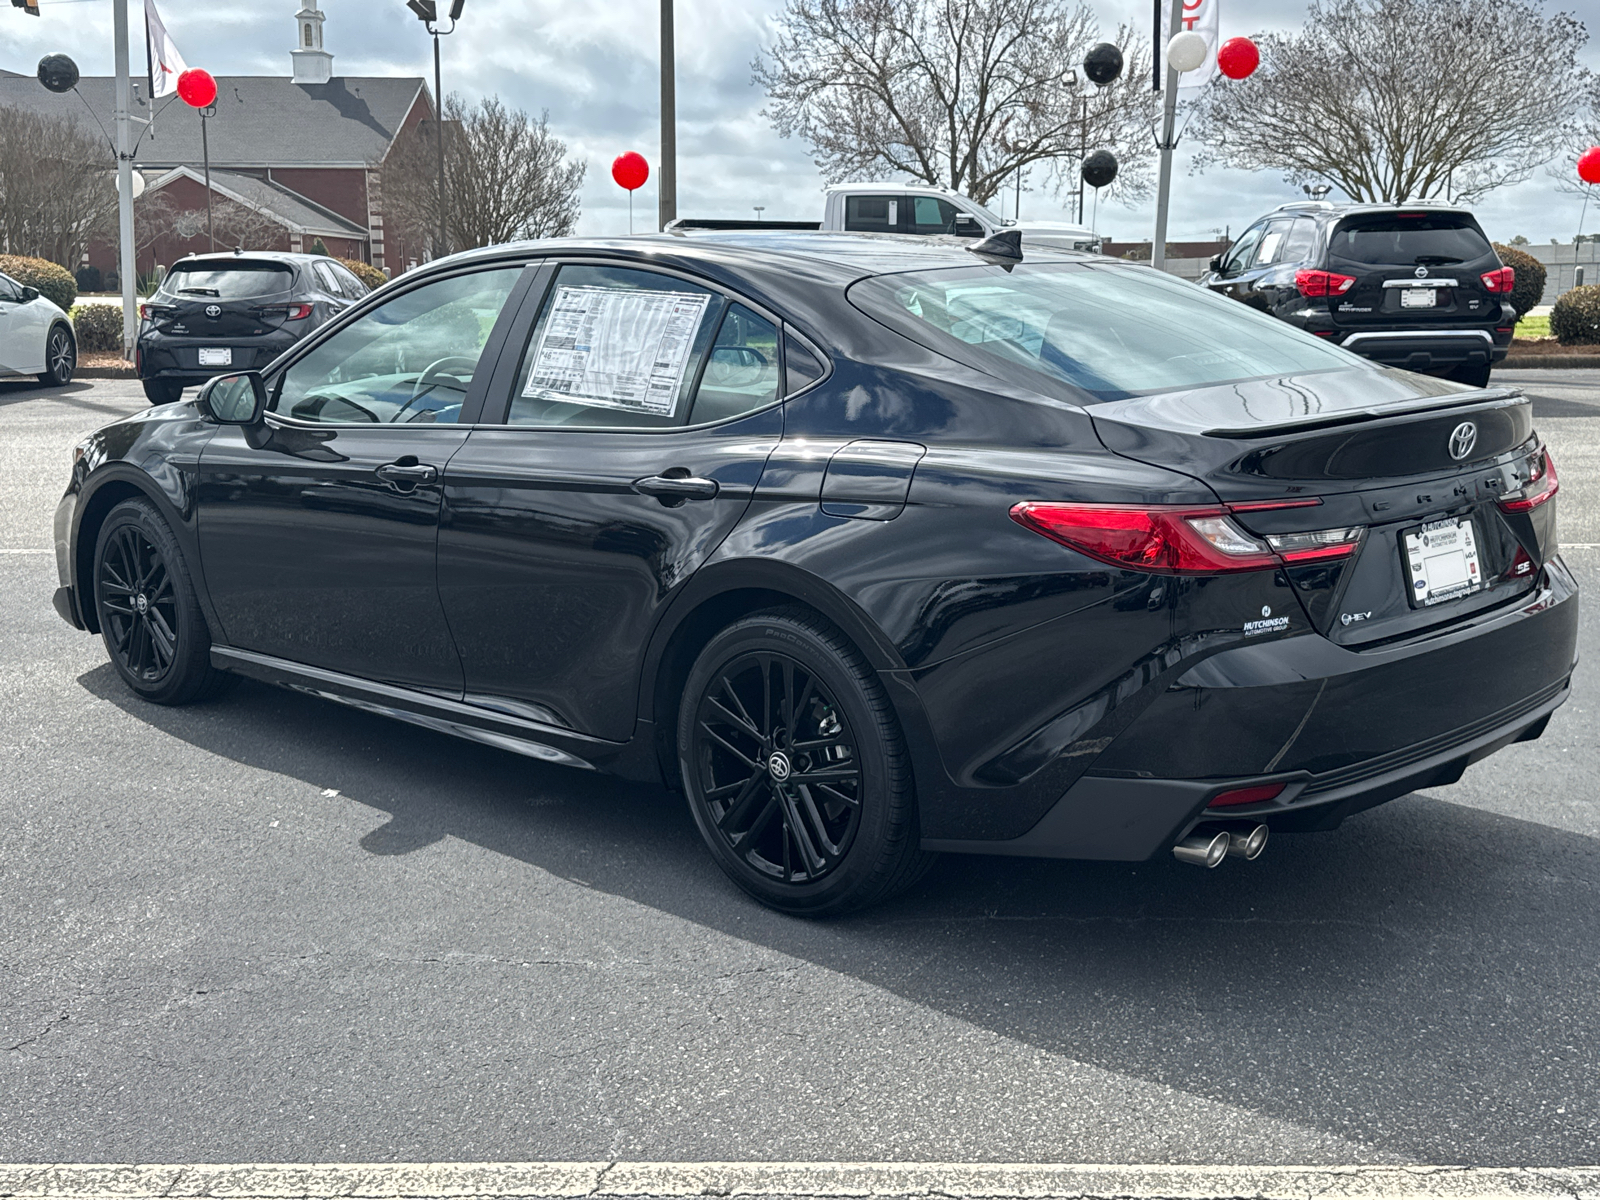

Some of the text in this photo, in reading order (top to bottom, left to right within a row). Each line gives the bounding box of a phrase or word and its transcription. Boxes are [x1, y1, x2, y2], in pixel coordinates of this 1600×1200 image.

[1428, 517, 1459, 531] HUTCHINSON
[1430, 531, 1457, 543] HUTCHINSON
[1517, 560, 1530, 575] SE
[1244, 617, 1289, 630] HUTCHINSON
[1244, 624, 1288, 636] AUTOMOTIVE GROUP
